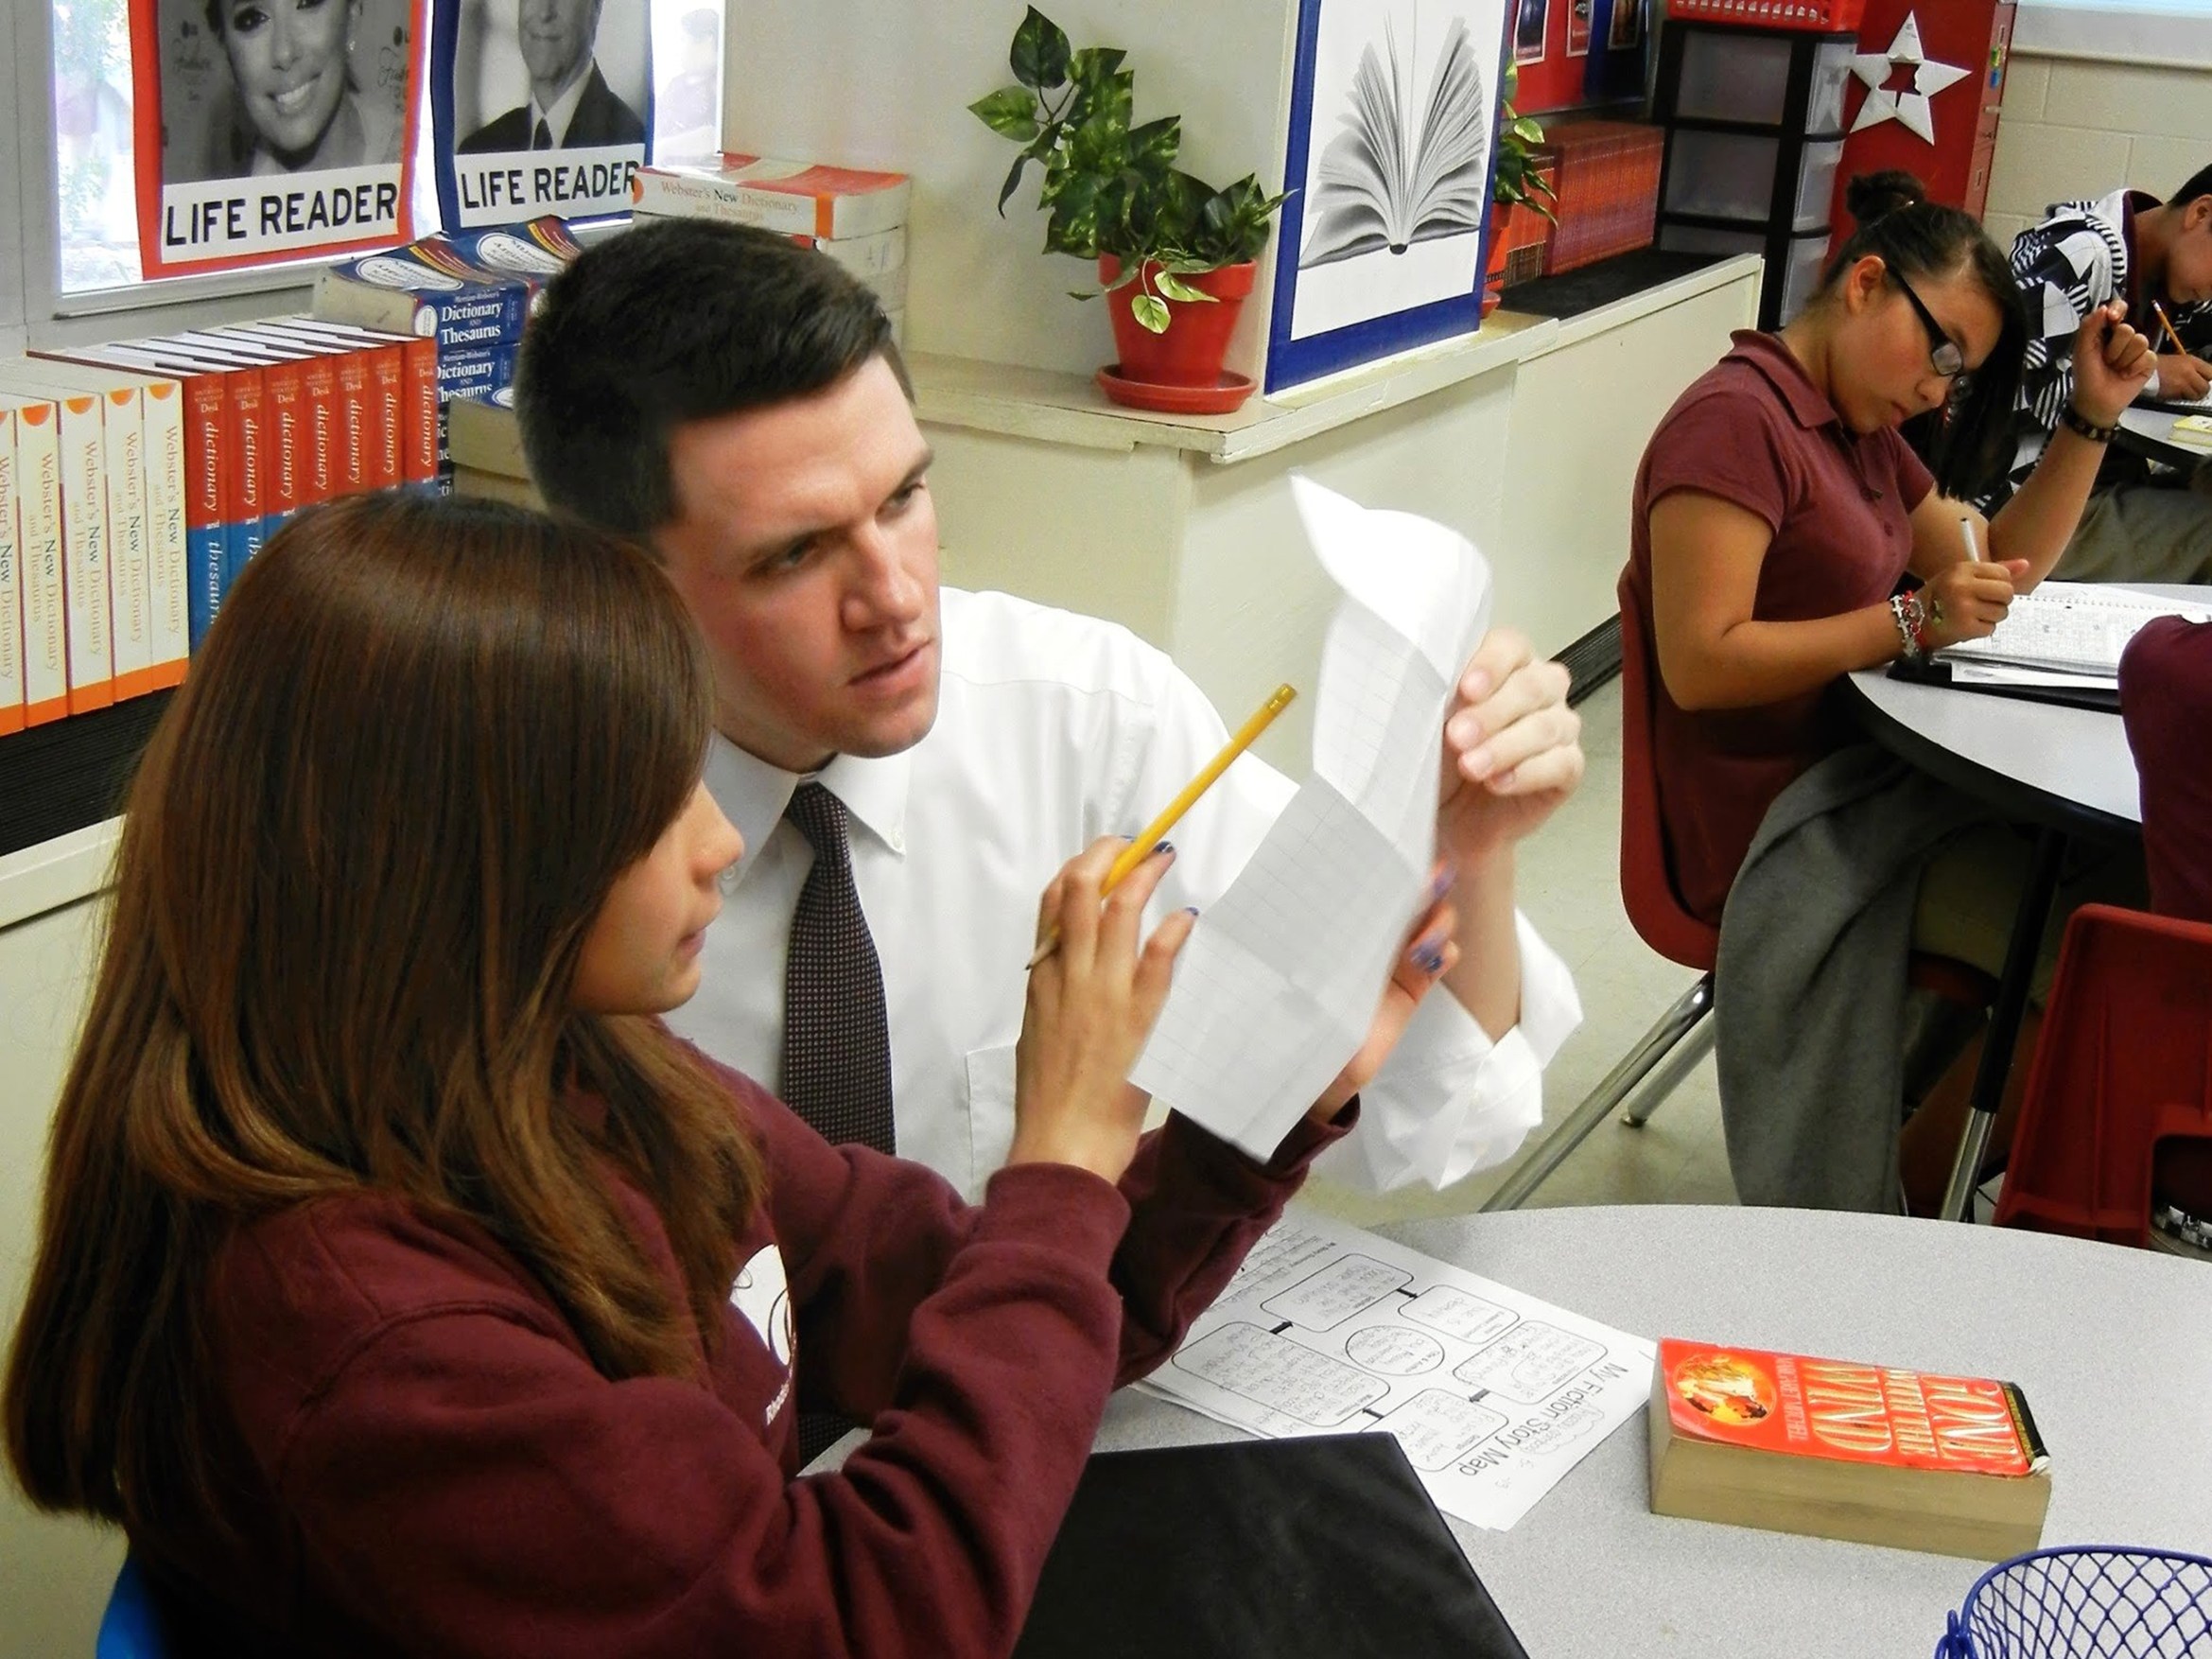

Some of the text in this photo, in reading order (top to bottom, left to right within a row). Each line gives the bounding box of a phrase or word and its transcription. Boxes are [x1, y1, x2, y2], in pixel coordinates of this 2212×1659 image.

[166, 183, 397, 246] LIFE READER
[462, 160, 639, 209] LIFE READER
[662, 181, 800, 214] Webster's New Dictionary
[441, 324, 501, 345] Thesaurus
[442, 303, 503, 322] Dictionary
[204, 422, 219, 512] dictionary
[244, 418, 258, 506] dictionary
[280, 411, 295, 498] dictionary
[315, 404, 329, 490] dictionary
[348, 399, 363, 483] dictionary
[383, 393, 397, 476] dictionary
[421, 385, 434, 467] dictionary
[0, 544, 12, 583] New
[42, 453, 59, 671] Webster's New Dictionary
[85, 441, 103, 656] Webster's New Dictionary
[126, 431, 143, 645] Webster's New Dictionary
[165, 426, 182, 635] Webster's New Dictionary
[1, 590, 13, 679] Dictionary
[1540, 1380, 1603, 1419] Fiction
[1589, 1362, 1629, 1382] My
[1802, 1362, 1892, 1452] WIND
[1884, 1369, 1938, 1458] WITH THE
[1458, 1447, 1509, 1476] Map
[1494, 1418, 1551, 1450] Story
[1921, 1374, 2023, 1465] GONE
